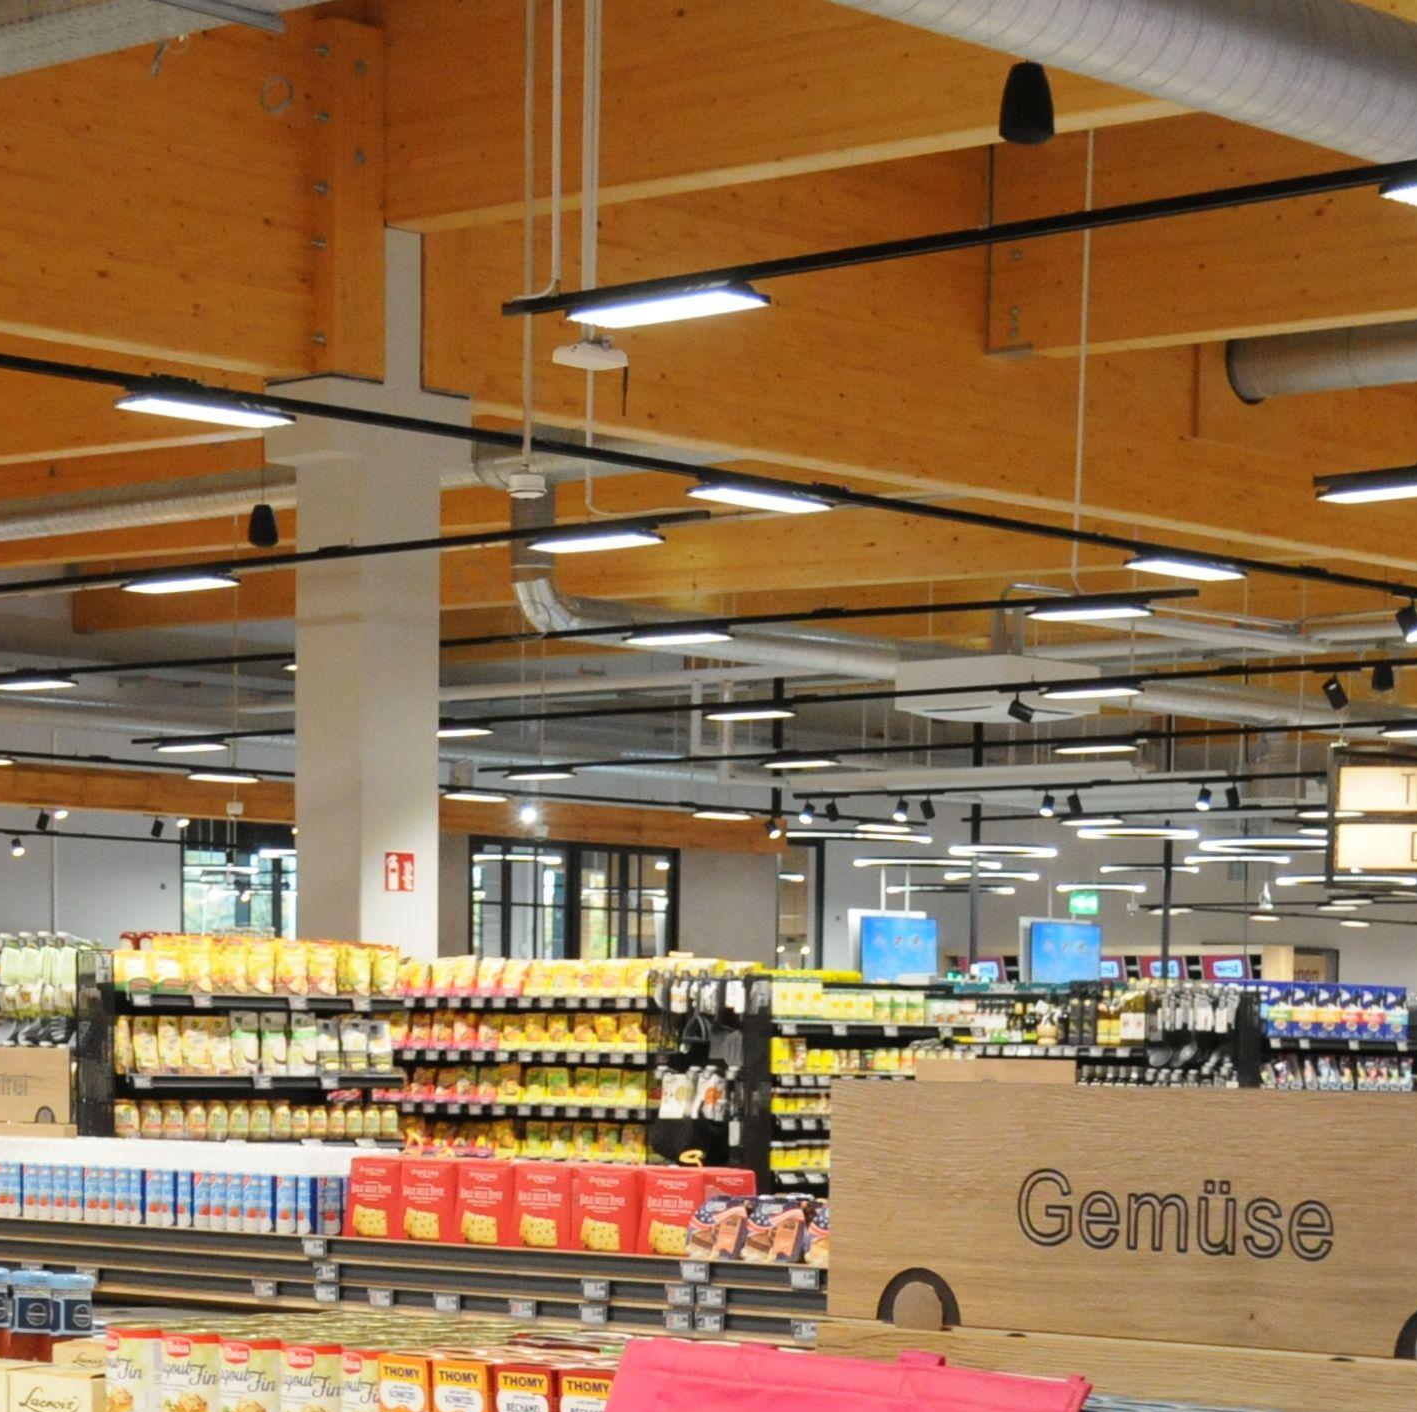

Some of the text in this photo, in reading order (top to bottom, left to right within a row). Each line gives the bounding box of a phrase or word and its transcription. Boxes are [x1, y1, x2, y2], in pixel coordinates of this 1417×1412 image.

[1017, 1167, 1334, 1262] Gemüse
[383, 1365, 420, 1380] THOMY
[438, 1370, 479, 1384] THOMY
[502, 1374, 545, 1389] THOMY
[565, 1379, 610, 1394] THOMY
